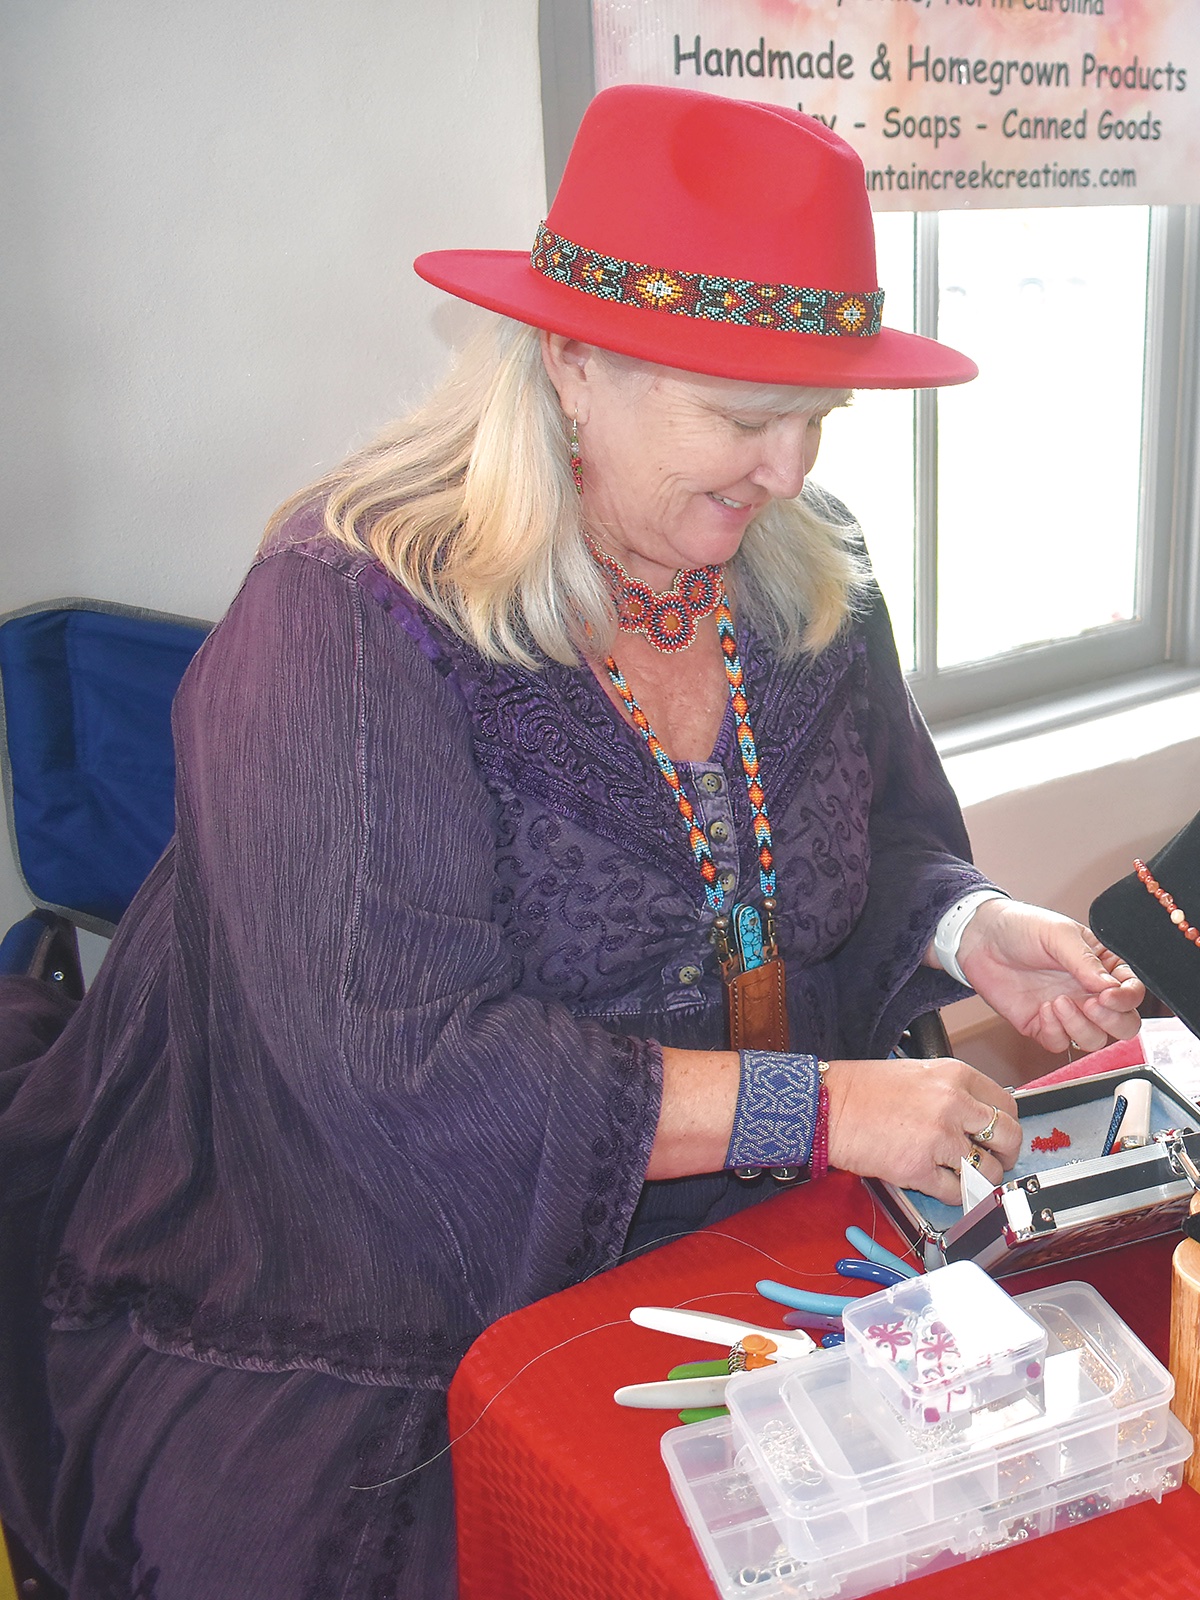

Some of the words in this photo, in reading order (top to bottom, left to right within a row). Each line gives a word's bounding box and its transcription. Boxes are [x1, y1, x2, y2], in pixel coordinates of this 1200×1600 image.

[673, 34, 854, 79] Handmade
[870, 42, 892, 81] &
[907, 44, 1069, 96] Homegrown
[1082, 52, 1187, 91] Products
[882, 106, 961, 149] Soaps
[1002, 108, 1087, 140] Canned
[1098, 110, 1161, 140] Goods
